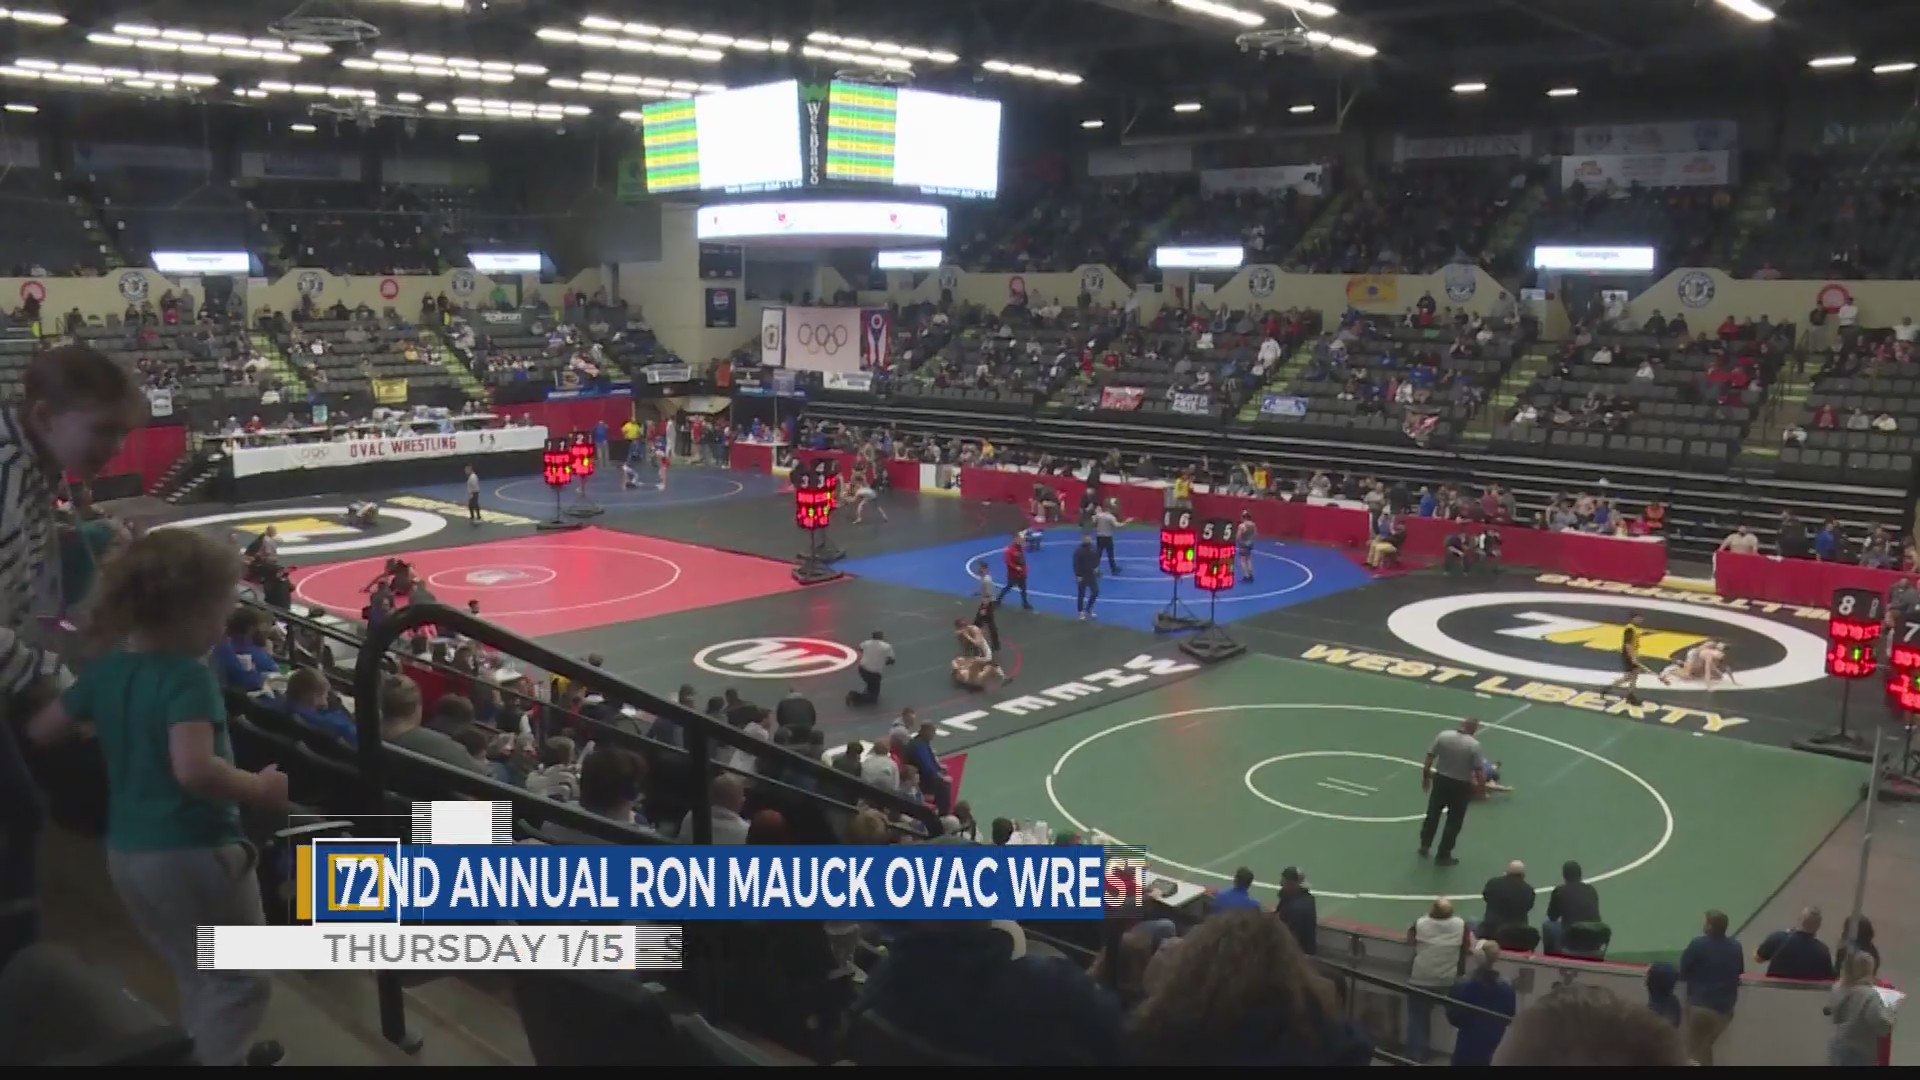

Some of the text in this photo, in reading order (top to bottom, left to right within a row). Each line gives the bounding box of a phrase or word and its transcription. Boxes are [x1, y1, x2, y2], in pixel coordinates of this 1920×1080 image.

[350, 436, 456, 458] OVAC WRESTLING
[1179, 513, 1190, 528] 6
[1203, 523, 1214, 540] 5
[1839, 595, 1856, 615] 8
[1903, 621, 1920, 642] 7
[1300, 643, 1751, 733] WEST LIBERTY
